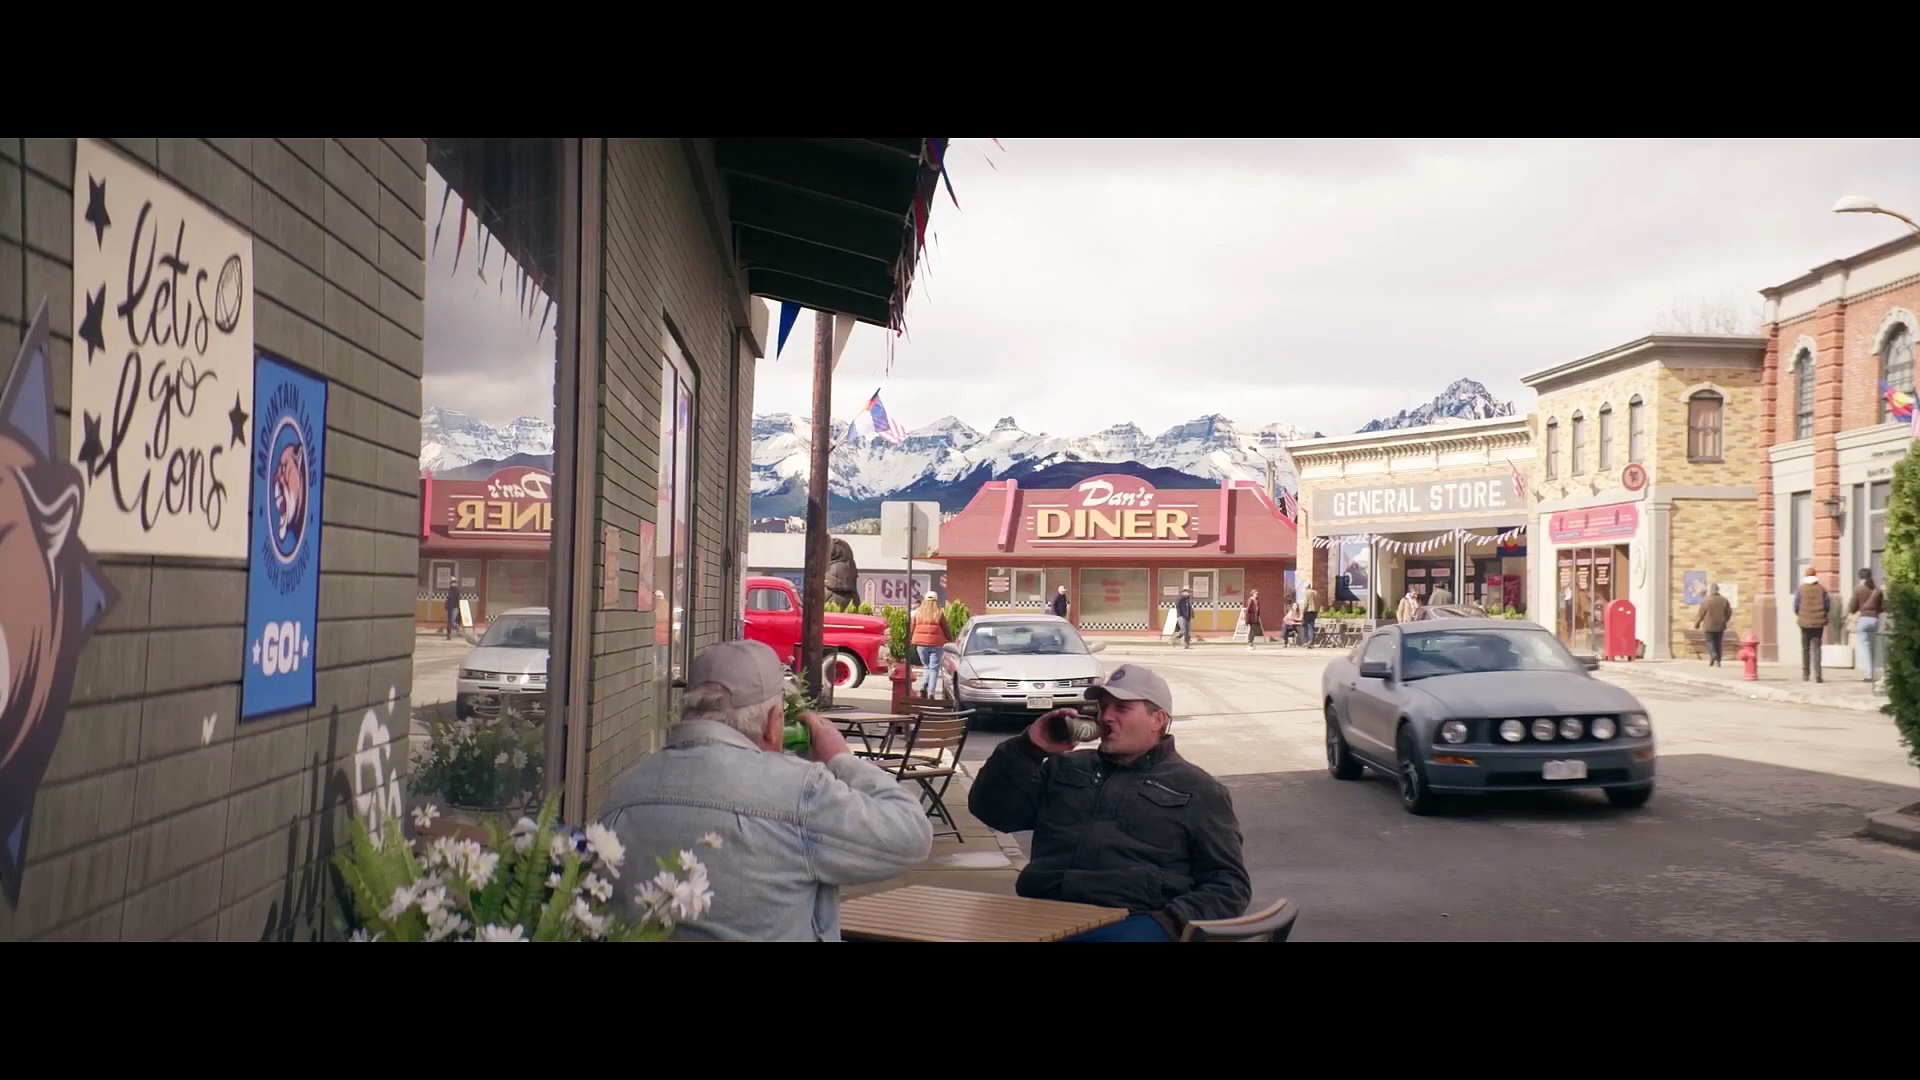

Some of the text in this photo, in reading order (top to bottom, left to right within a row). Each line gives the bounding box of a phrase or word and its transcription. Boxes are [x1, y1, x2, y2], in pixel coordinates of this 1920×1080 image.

[117, 199, 214, 355] lets
[148, 356, 219, 459] go
[256, 381, 317, 489] MOUNTAIN LIONS
[95, 349, 228, 533] lions
[1078, 479, 1155, 507] Dan's
[1333, 479, 1507, 517] GENERAL STORE.
[1036, 508, 1190, 540] DINER
[262, 535, 311, 597] HIGH GROUND
[881, 578, 922, 601] GAS
[262, 620, 300, 678] GO!
